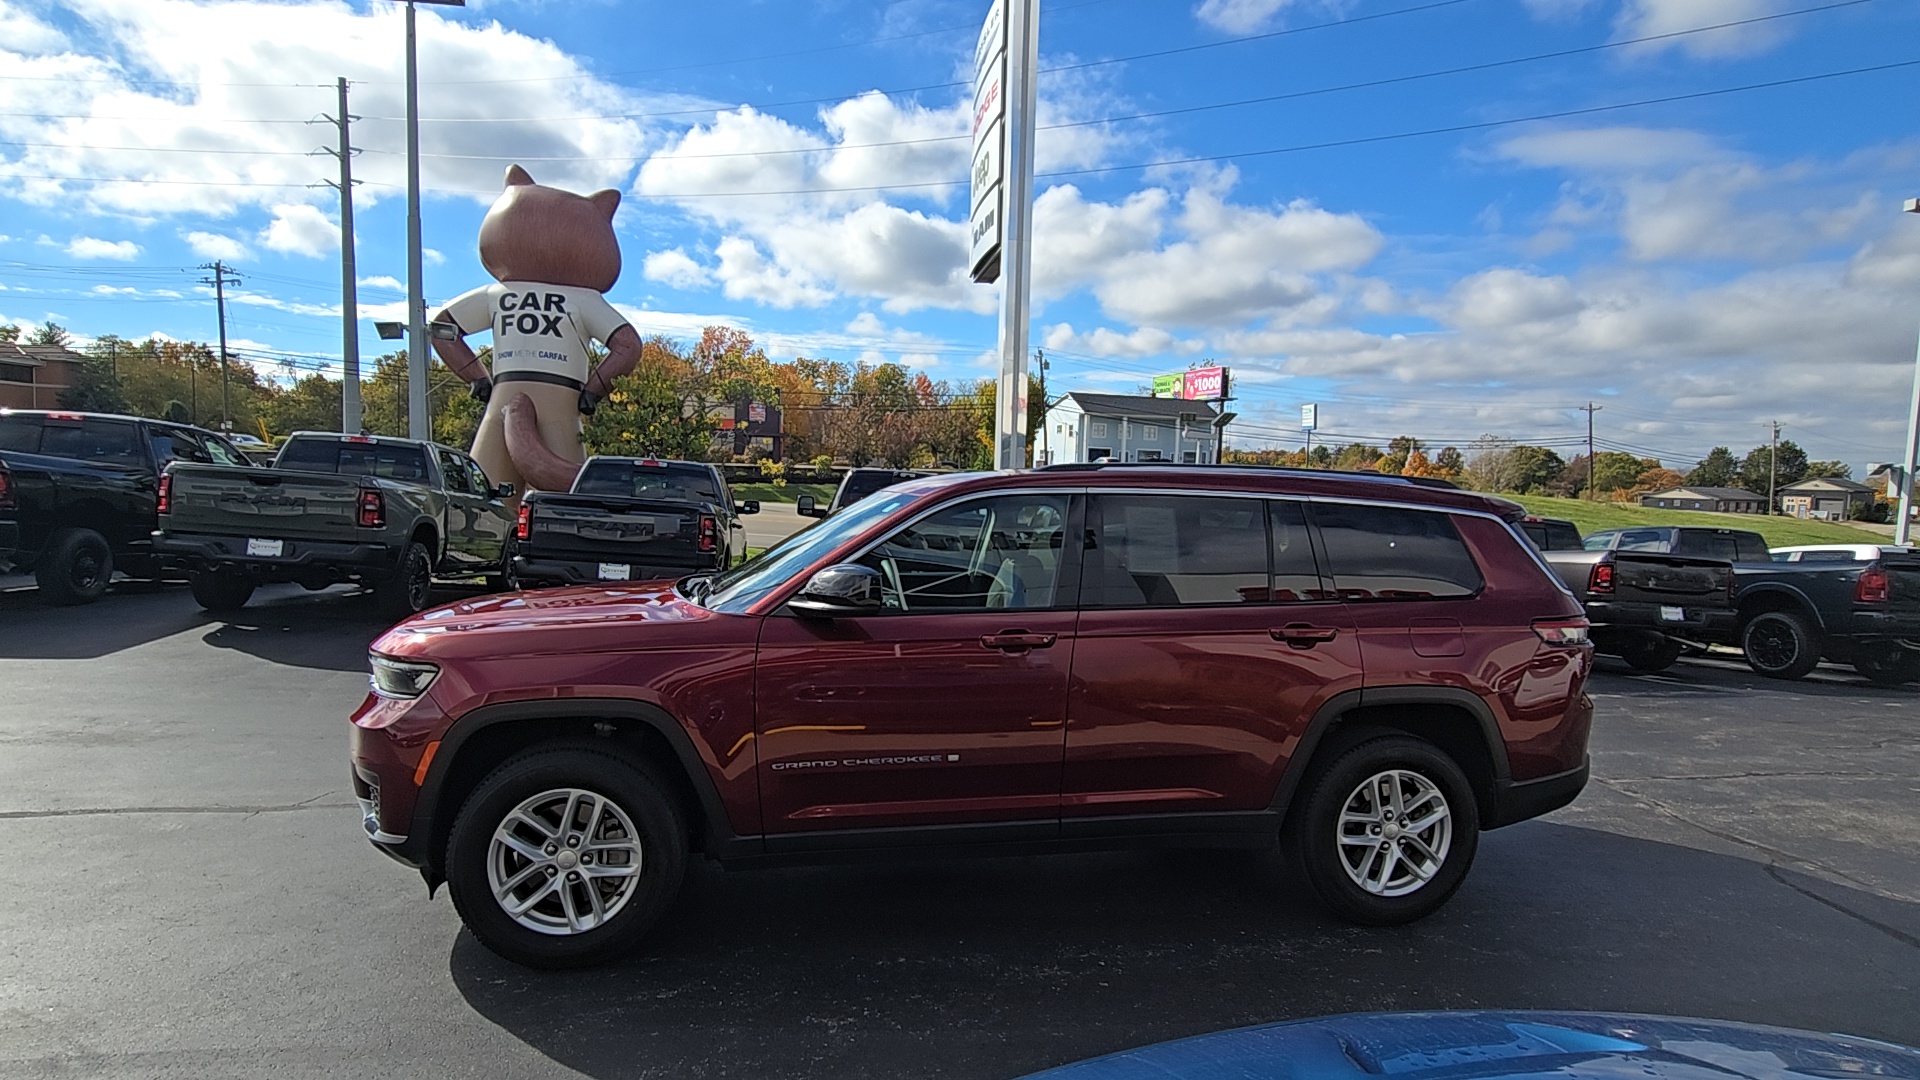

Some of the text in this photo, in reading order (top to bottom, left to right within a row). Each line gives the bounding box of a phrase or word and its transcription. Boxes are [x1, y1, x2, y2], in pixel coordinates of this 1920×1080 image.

[499, 291, 567, 314] CAR
[500, 313, 564, 339] FOX
[498, 350, 568, 362] SHOW ME THE CARFAX
[221, 492, 307, 507] RAM
[771, 760, 838, 770] GRAND
[843, 754, 943, 767] CHEROKEE
